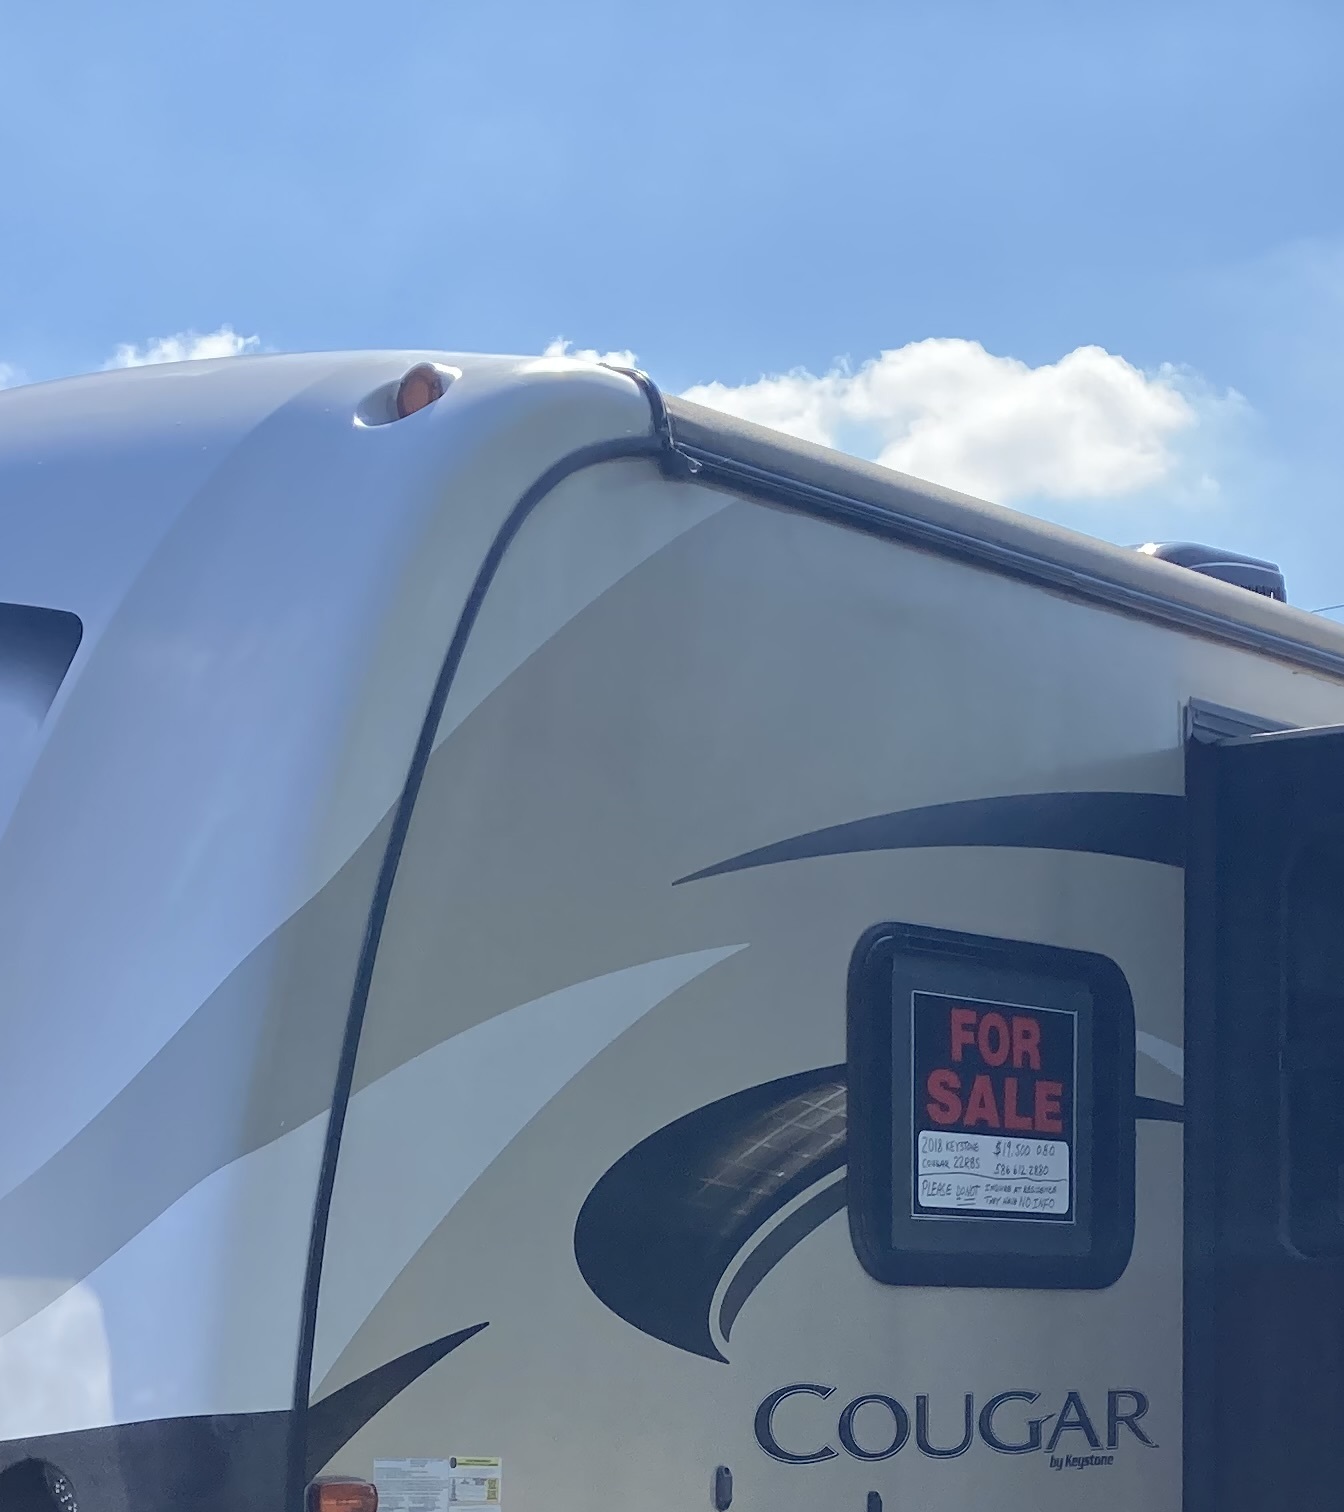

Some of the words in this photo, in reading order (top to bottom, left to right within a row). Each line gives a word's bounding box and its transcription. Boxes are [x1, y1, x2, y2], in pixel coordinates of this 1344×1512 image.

[951, 1007, 1041, 1071] FOR
[926, 1068, 1063, 1133] SALE
[921, 1135, 943, 1154] 2018
[921, 1179, 953, 1198] PLEASE
[753, 1382, 1160, 1465] COUGAR
[1049, 1454, 1064, 1471] by
[1064, 1454, 1115, 1471] Keystone
